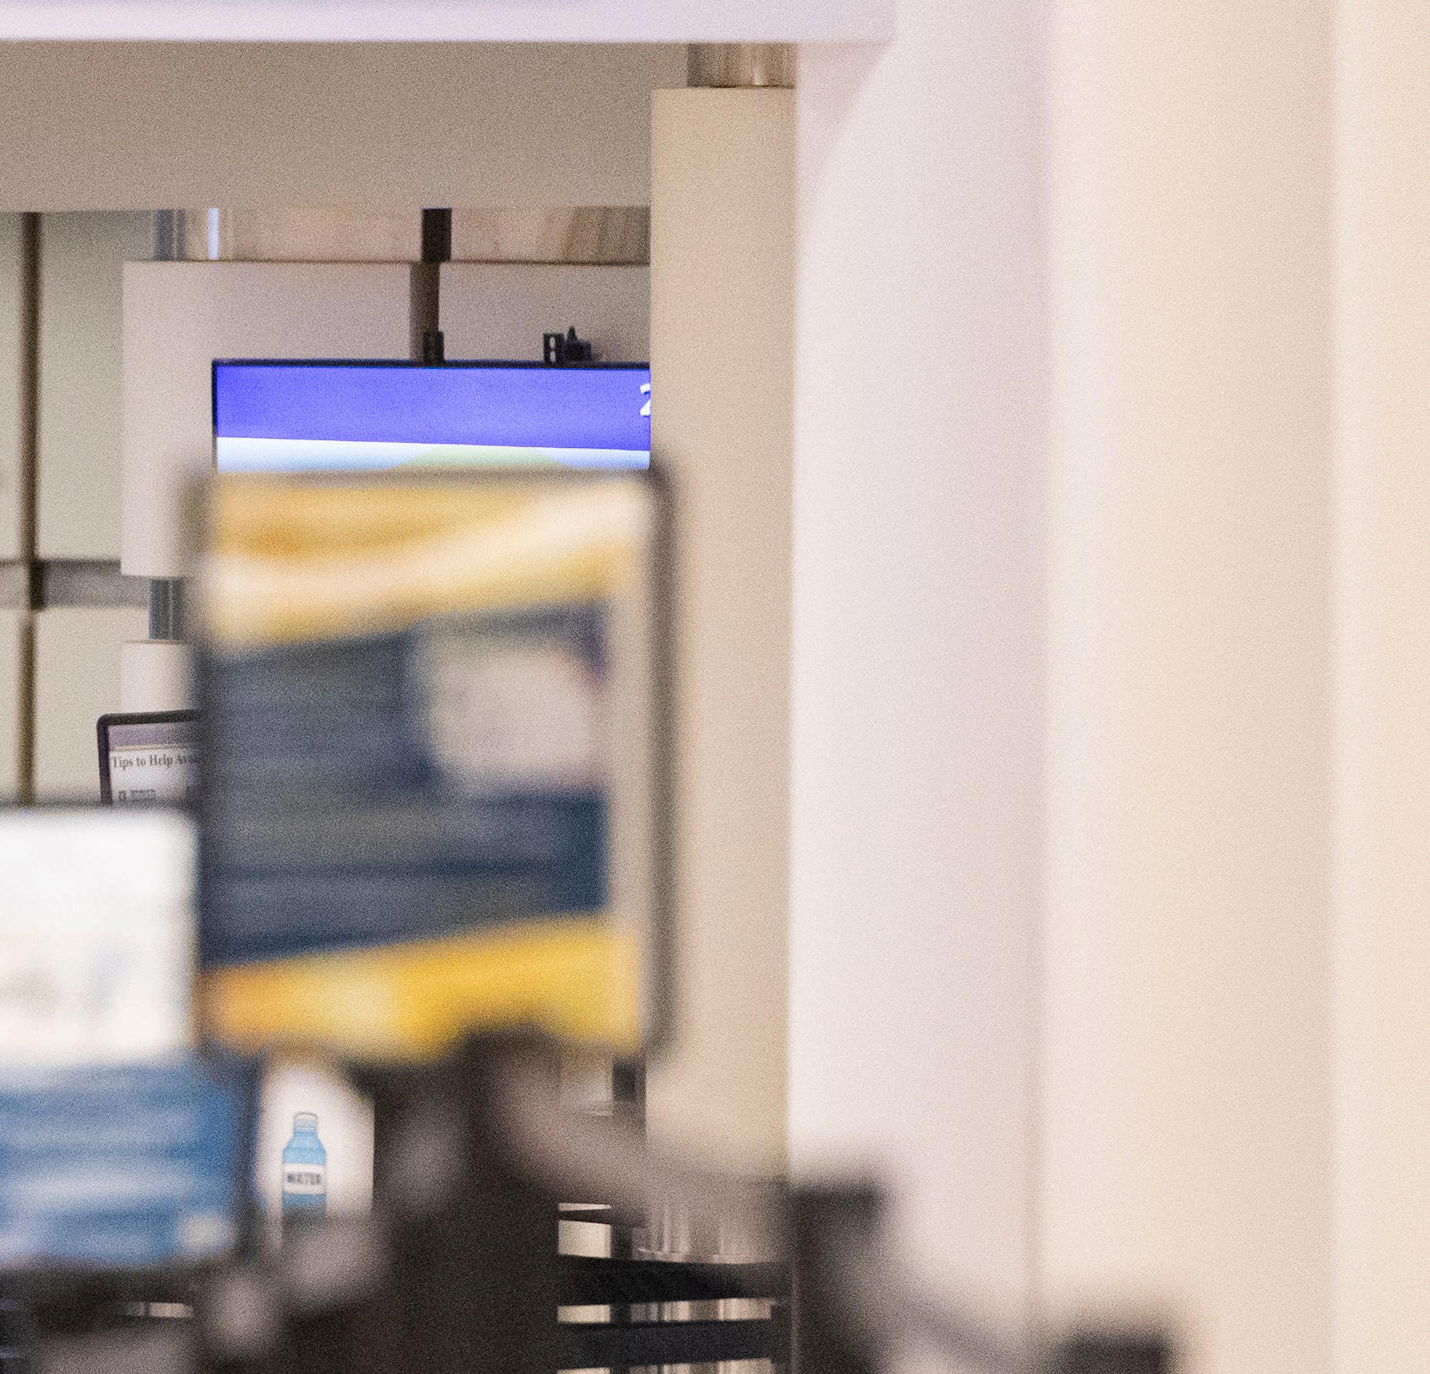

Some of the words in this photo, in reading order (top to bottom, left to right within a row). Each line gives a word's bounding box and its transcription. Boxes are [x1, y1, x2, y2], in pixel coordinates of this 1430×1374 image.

[112, 756, 134, 771] Tips
[136, 757, 146, 766] to
[149, 754, 173, 768] Help
